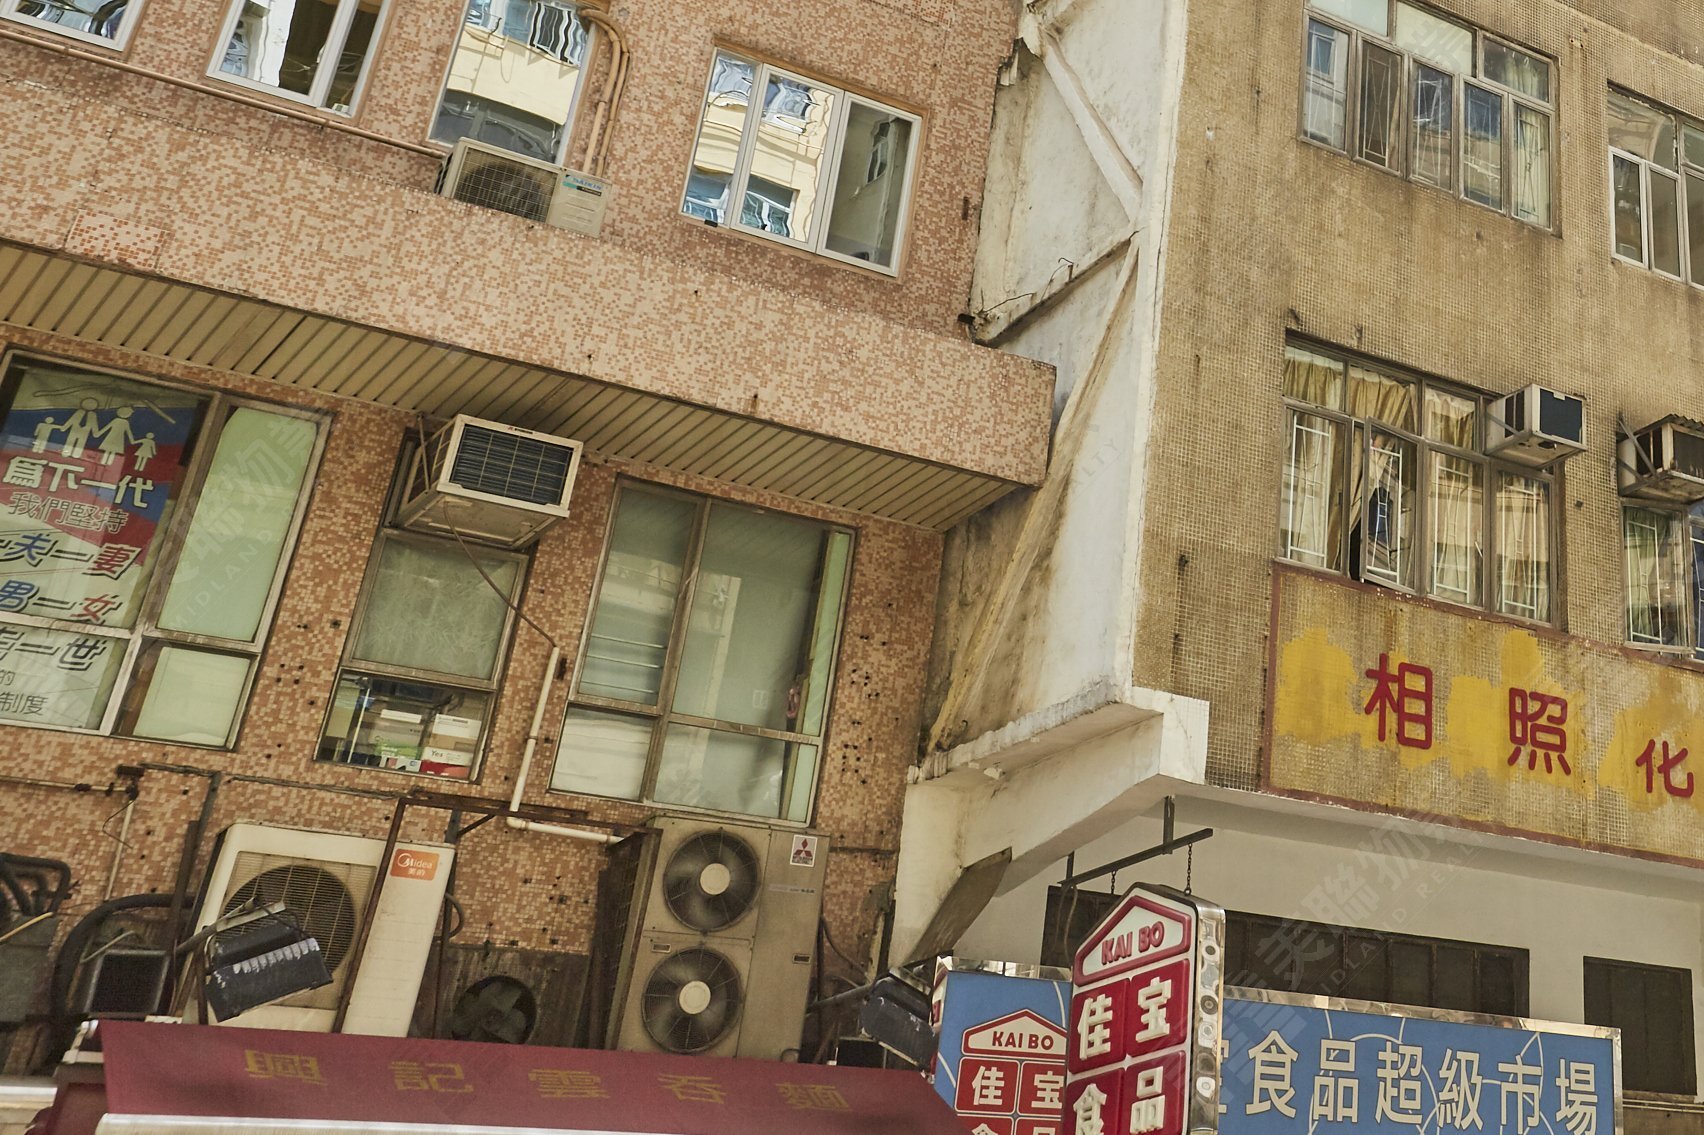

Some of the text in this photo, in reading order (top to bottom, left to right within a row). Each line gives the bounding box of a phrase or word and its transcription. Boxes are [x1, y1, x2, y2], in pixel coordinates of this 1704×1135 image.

[8, 491, 129, 534] 我們堅持
[0, 531, 141, 581] 夫一妻
[1101, 921, 1165, 966] KAI BO
[992, 1030, 1054, 1051] KAI BO
[1073, 1066, 1165, 1135] 食品
[1218, 1029, 1598, 1135] 食品超級市場
